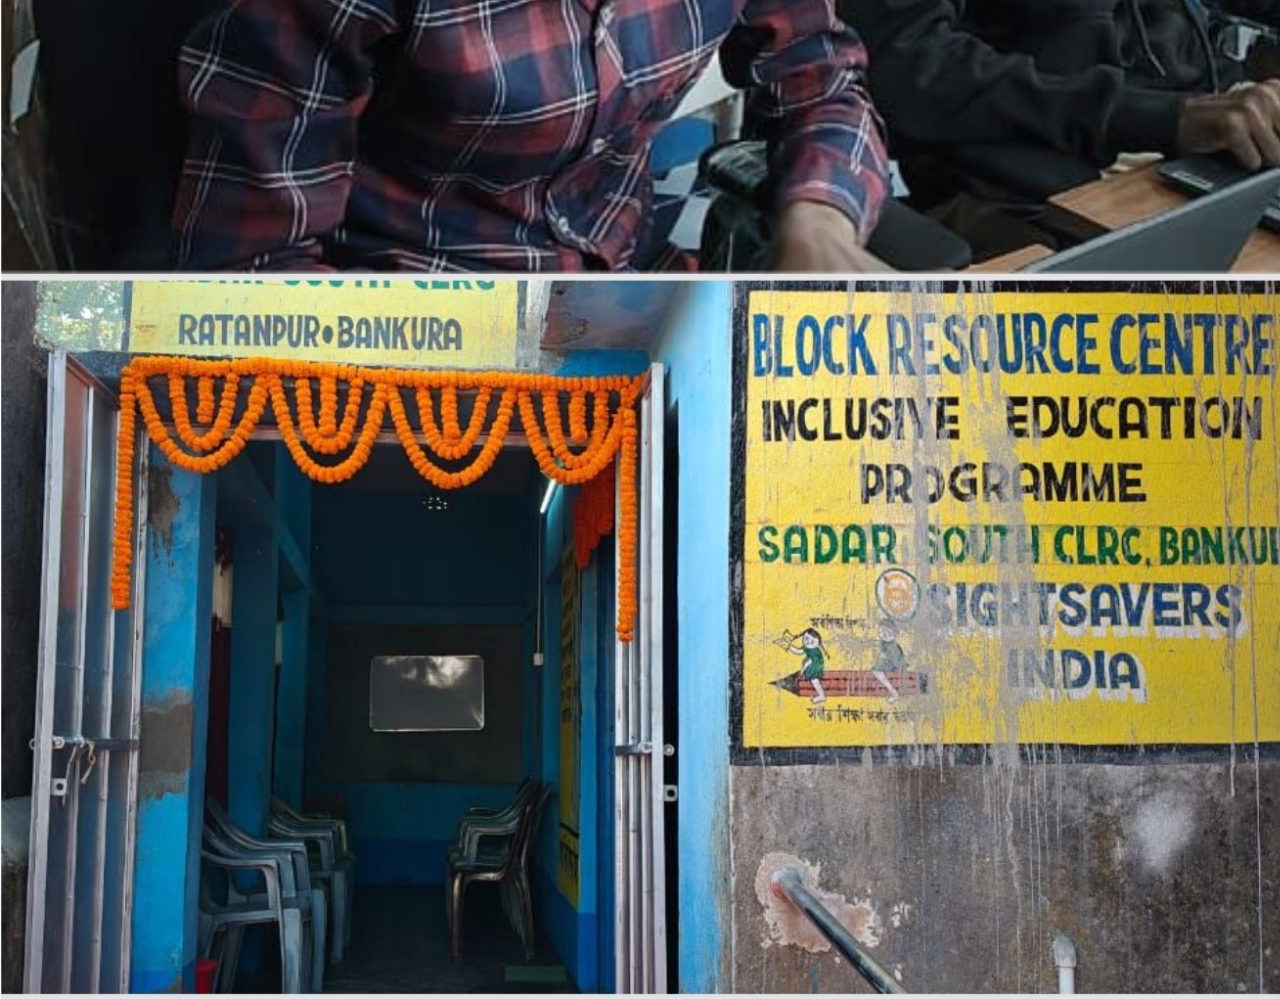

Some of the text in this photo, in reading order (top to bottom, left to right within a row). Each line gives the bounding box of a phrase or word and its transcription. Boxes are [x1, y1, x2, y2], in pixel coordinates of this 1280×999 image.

[753, 312, 1274, 377] BLOCK RESOURCE CENTRE
[761, 394, 1262, 442] INCLUSIVE EDUCATION
[860, 461, 1147, 504] PROGRAMME
[757, 522, 897, 565] SADAR
[927, 523, 1038, 566] SOUTH
[925, 582, 1245, 632] SIGHTSAVERS
[1007, 649, 1143, 693] INDIA
